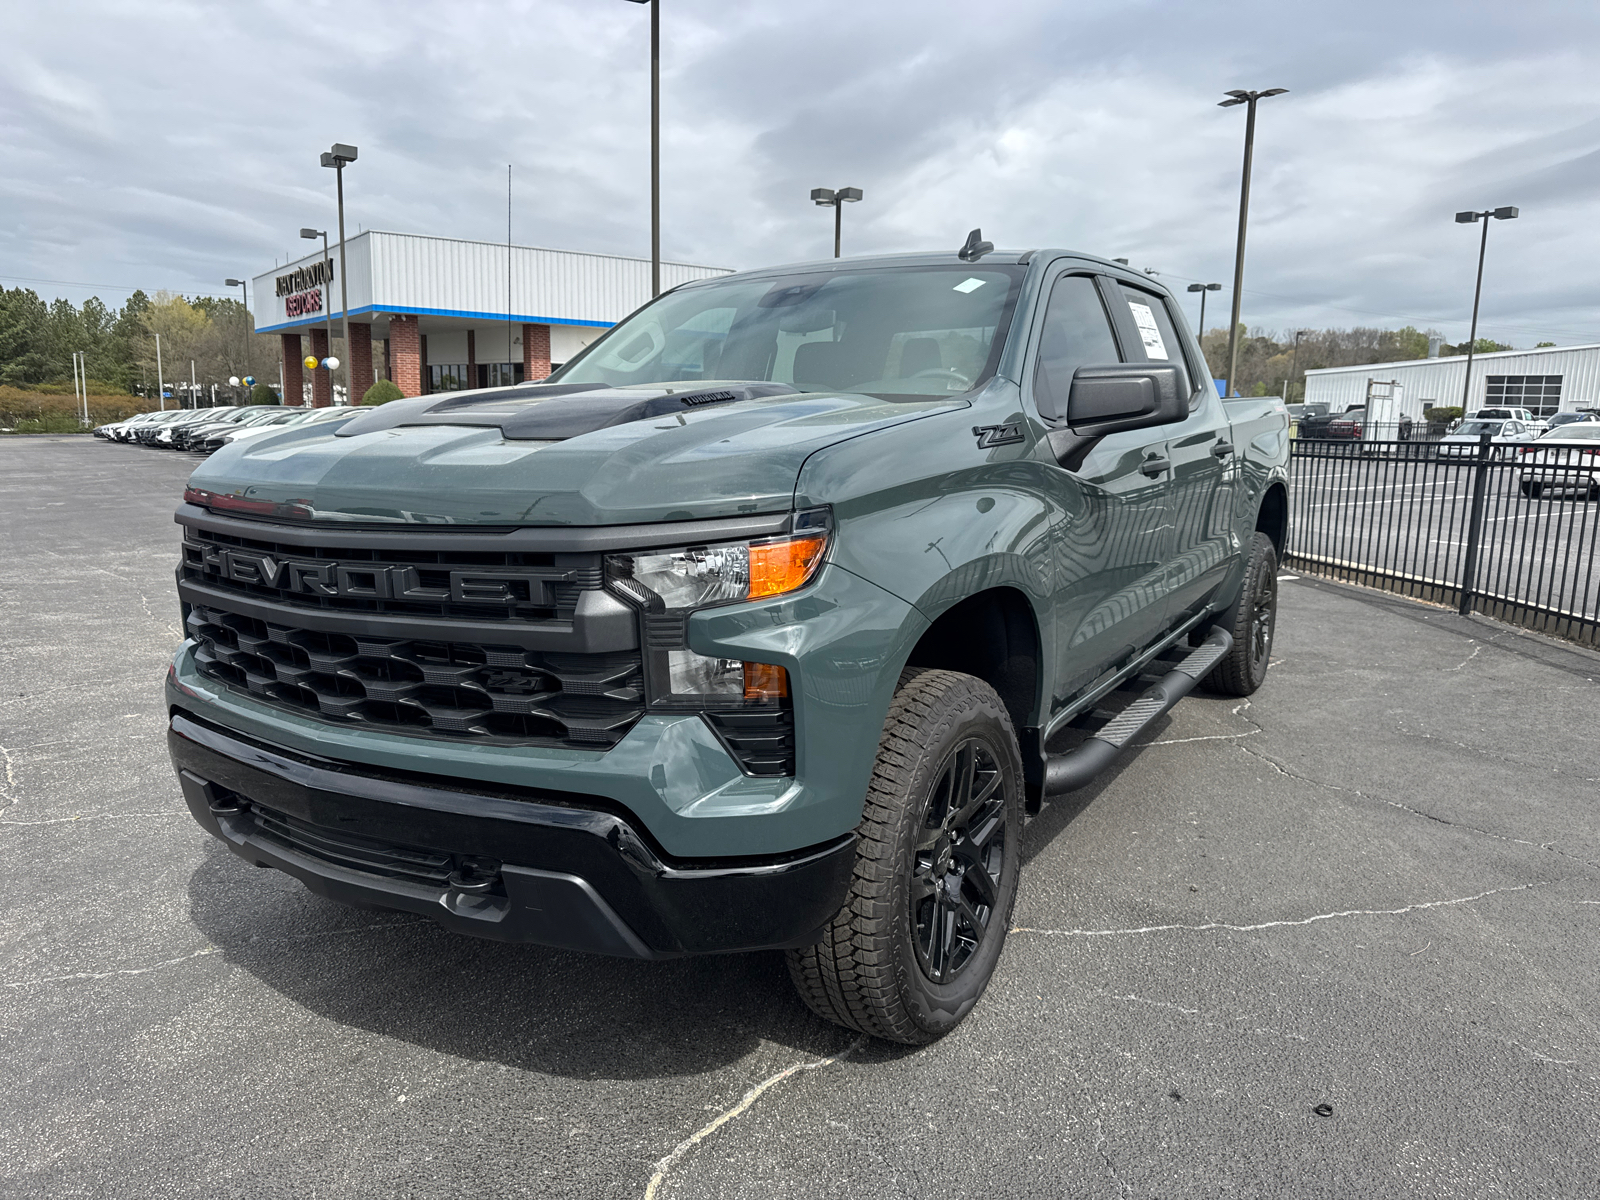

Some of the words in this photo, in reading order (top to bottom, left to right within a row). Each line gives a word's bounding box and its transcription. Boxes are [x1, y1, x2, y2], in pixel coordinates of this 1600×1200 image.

[285, 294, 302, 317] USED
[301, 289, 322, 313] CARS
[972, 421, 1025, 449] Z71
[182, 542, 577, 606] CHEVROLET
